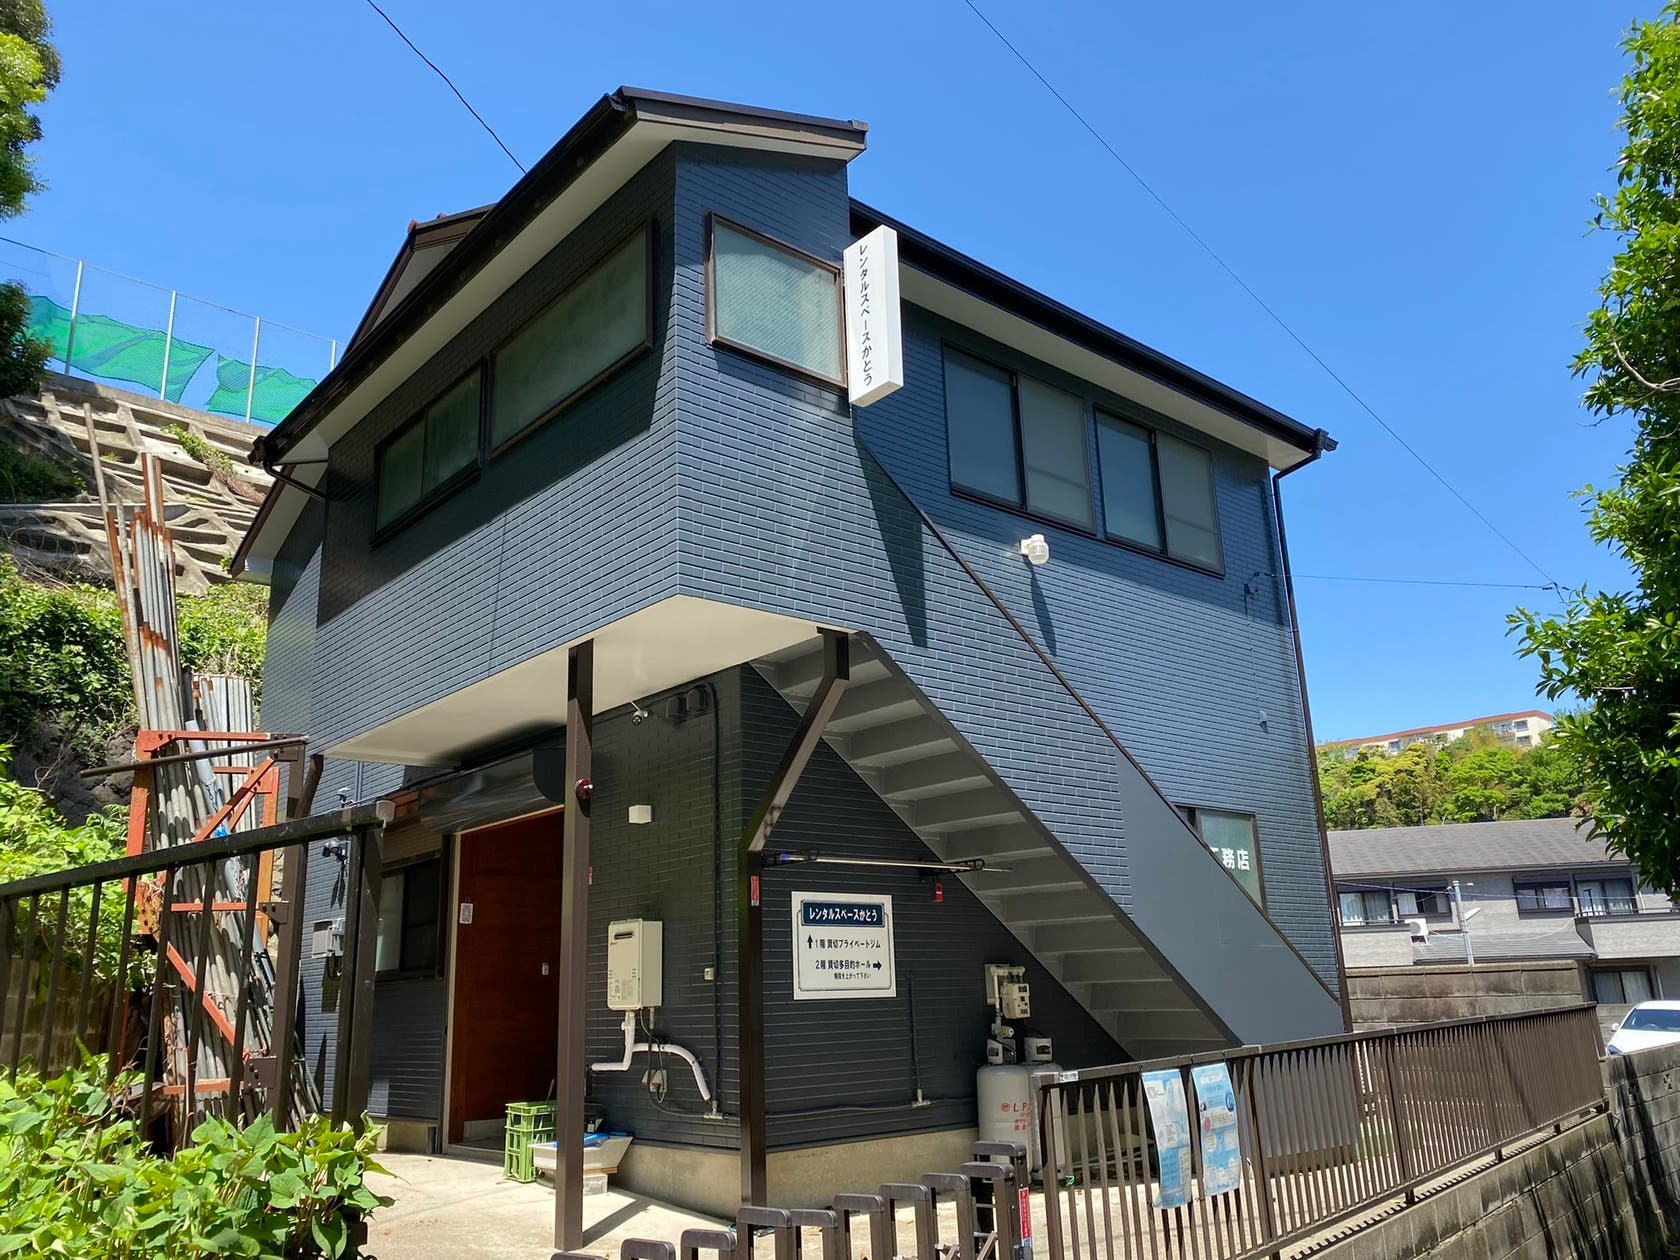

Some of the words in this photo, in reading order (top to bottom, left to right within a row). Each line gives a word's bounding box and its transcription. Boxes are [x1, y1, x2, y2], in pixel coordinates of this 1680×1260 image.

[859, 244, 873, 386] レンタルスペースかとう
[809, 908, 878, 921] レンタルスペースかとう
